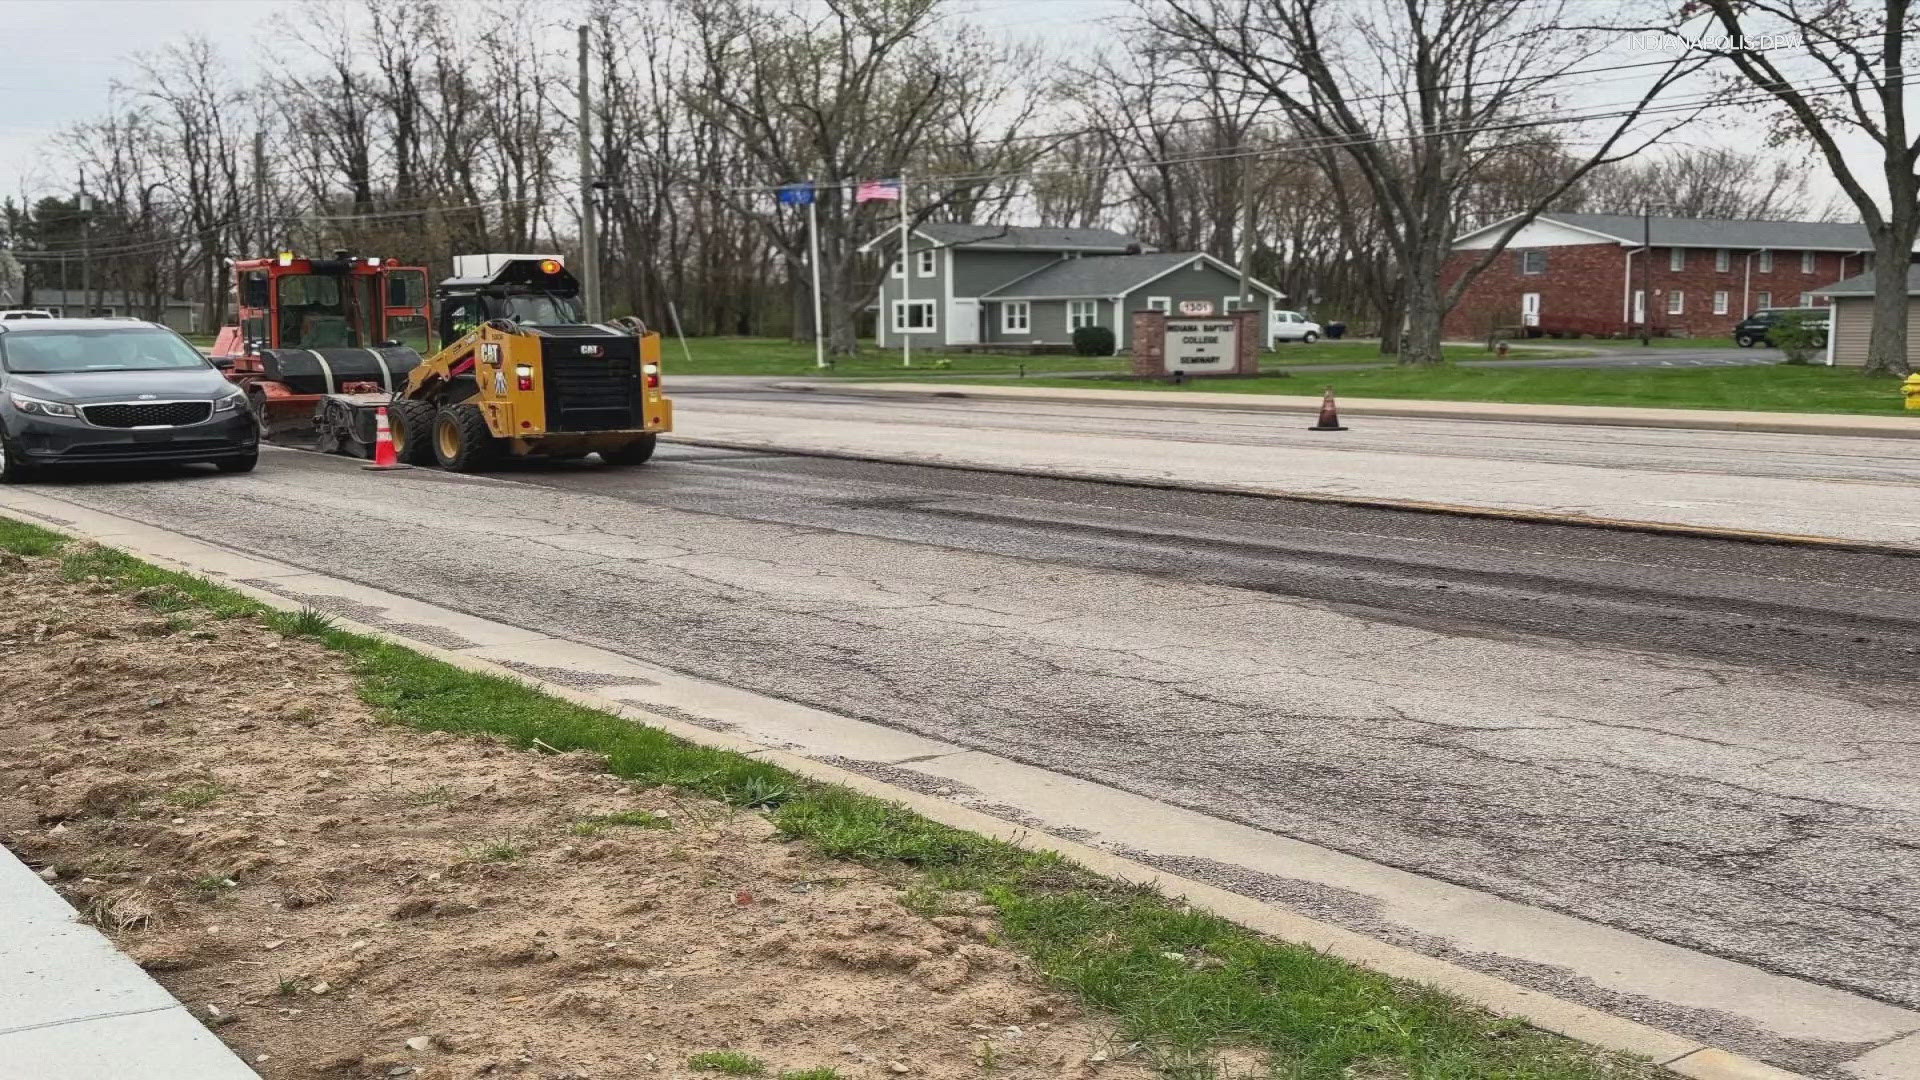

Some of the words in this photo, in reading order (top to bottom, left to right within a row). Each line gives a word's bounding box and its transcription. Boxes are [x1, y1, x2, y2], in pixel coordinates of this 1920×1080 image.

[1184, 303, 1208, 311] 1301
[1183, 336, 1218, 344] COLLEGE
[481, 343, 498, 363] CAT
[580, 345, 598, 354] CAT
